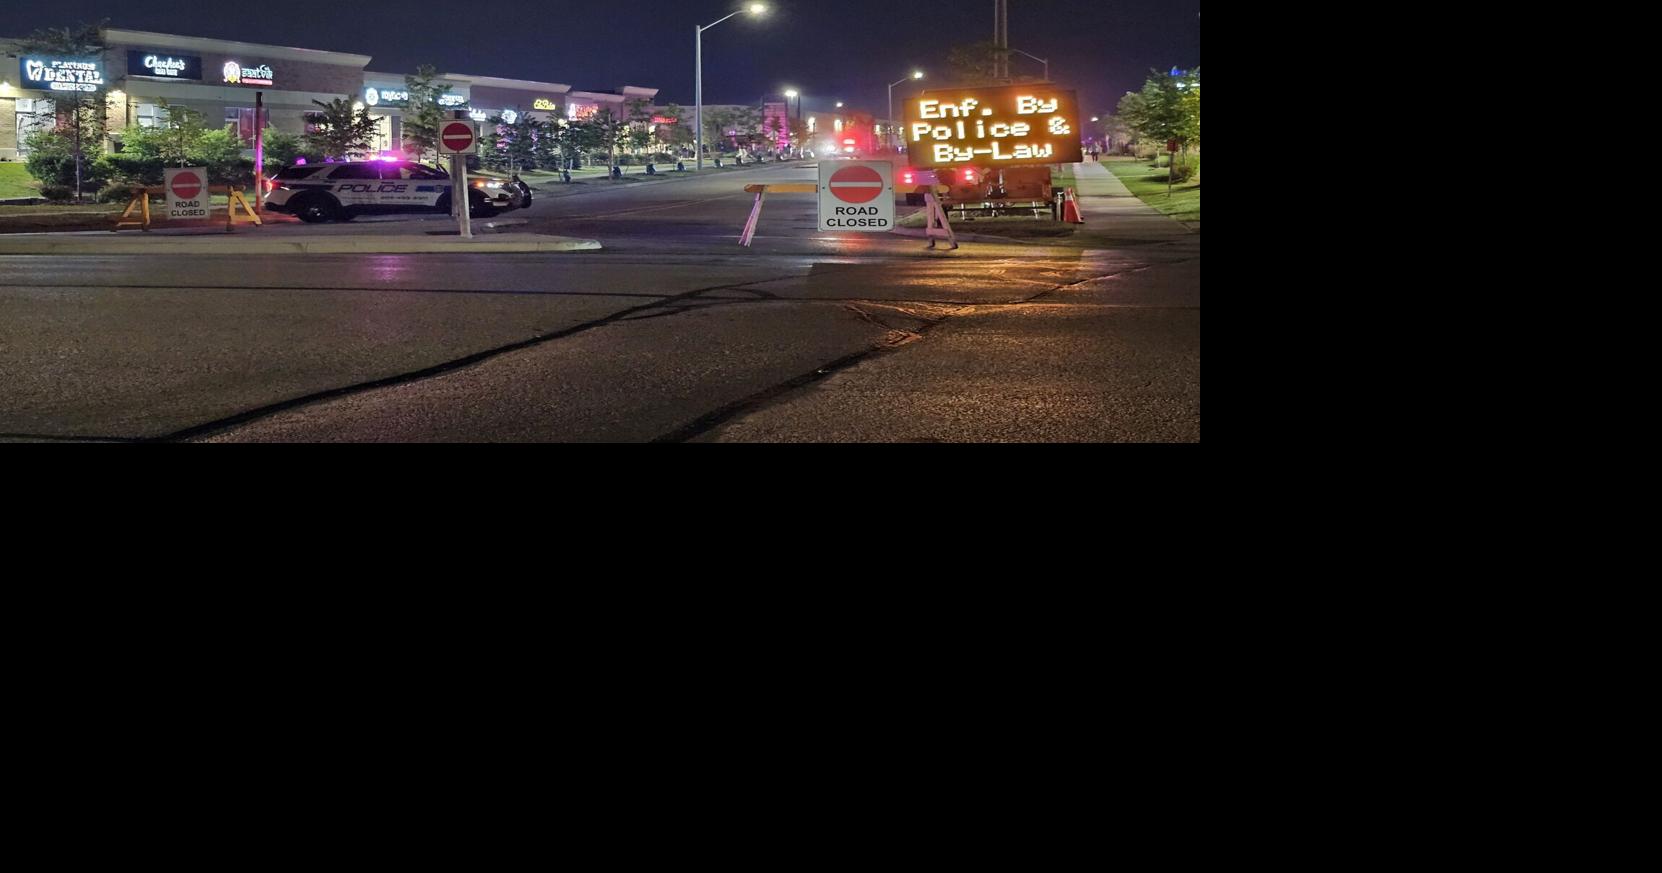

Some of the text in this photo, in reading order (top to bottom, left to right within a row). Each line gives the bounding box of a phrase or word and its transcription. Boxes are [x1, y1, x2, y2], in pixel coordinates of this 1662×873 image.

[44, 68, 104, 84] DENTAL
[919, 95, 1059, 119] Enf. By
[912, 116, 1072, 141] Police &
[933, 141, 1053, 162] By-Law
[338, 184, 408, 193] POLICE
[835, 206, 879, 215] ROAD
[826, 218, 888, 227] CLOSED
